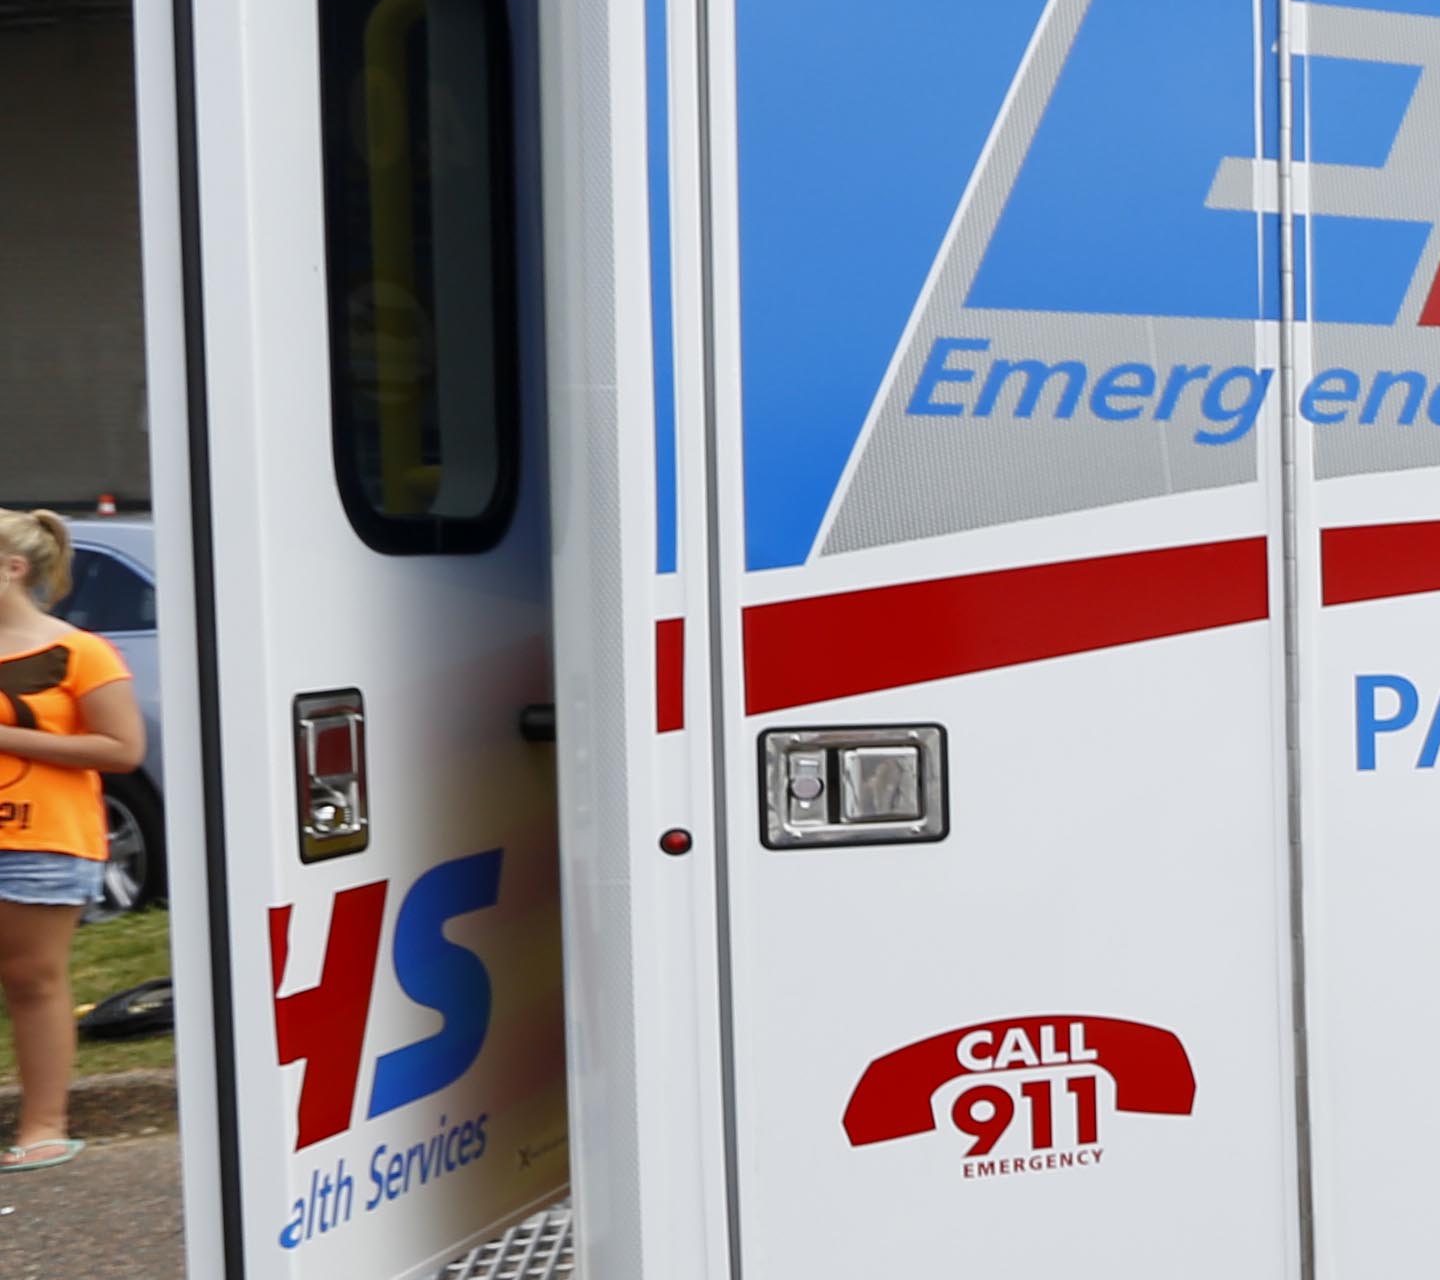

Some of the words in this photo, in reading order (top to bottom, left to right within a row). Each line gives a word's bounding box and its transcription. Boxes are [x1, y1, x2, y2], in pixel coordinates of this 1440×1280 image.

[956, 1021, 1098, 1072] CALL
[951, 1073, 1098, 1158] 911
[279, 1159, 354, 1250] alth
[365, 1114, 489, 1213] Services
[962, 1149, 1104, 1179] EMERGENCY
